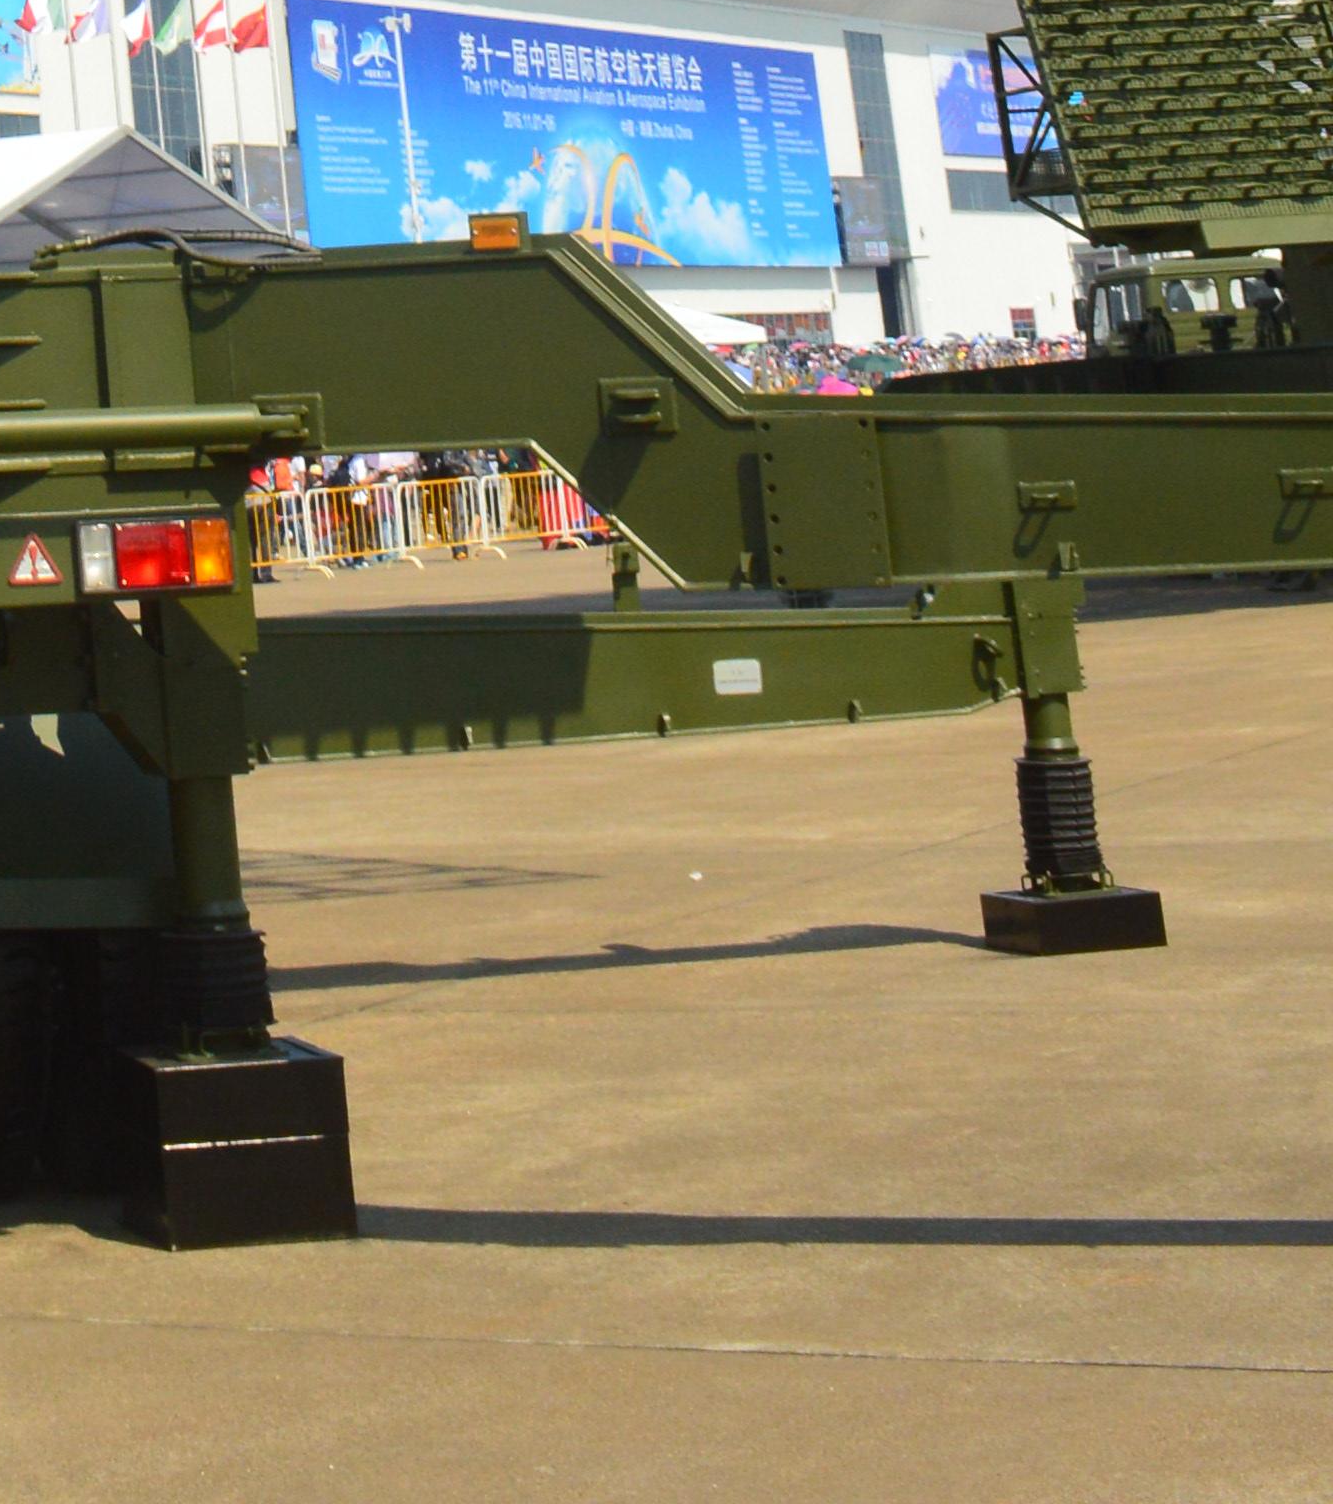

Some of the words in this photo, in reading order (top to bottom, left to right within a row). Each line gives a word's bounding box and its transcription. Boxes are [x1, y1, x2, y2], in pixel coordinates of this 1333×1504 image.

[458, 31, 704, 92] 第十一届中国国际航空航天博览会
[462, 74, 481, 96] The
[501, 78, 528, 100] China
[529, 81, 582, 104] International
